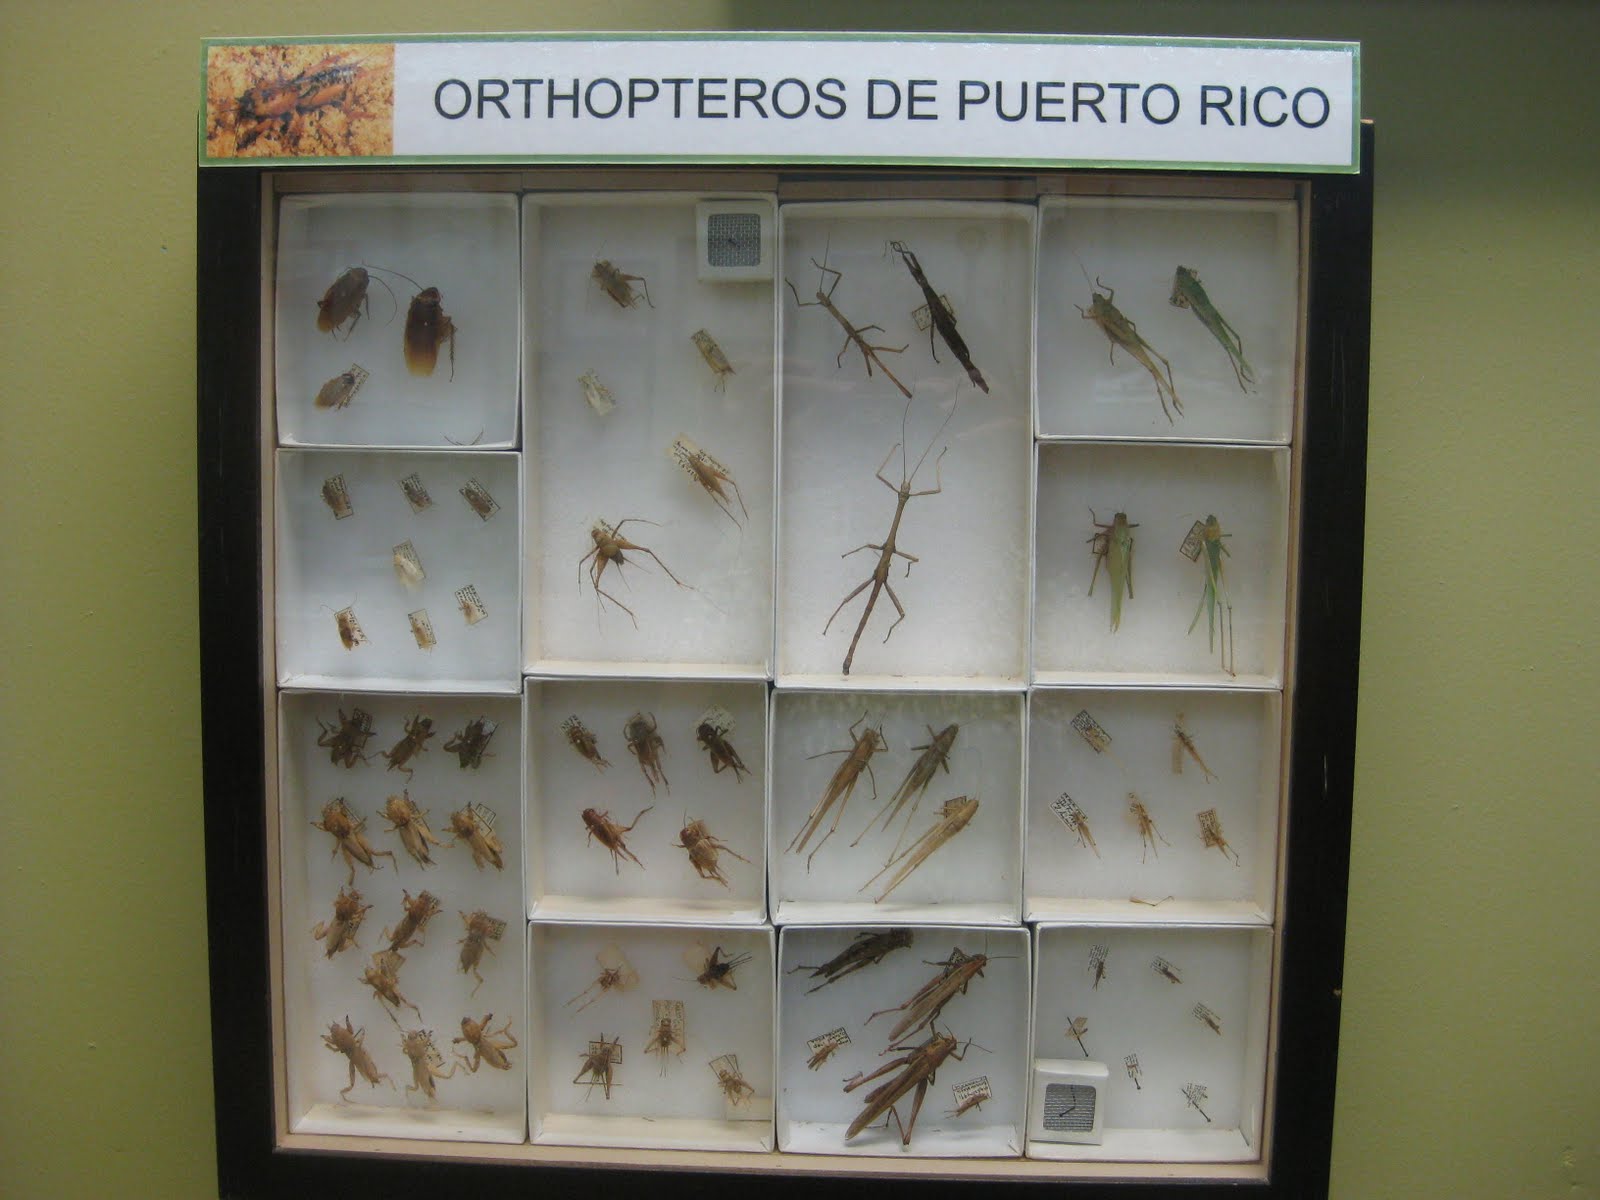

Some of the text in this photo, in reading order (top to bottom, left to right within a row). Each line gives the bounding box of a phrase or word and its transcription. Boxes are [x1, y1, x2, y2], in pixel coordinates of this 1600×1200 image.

[434, 78, 1331, 129] ORTHOPTEROS DE PUERTO RICO
